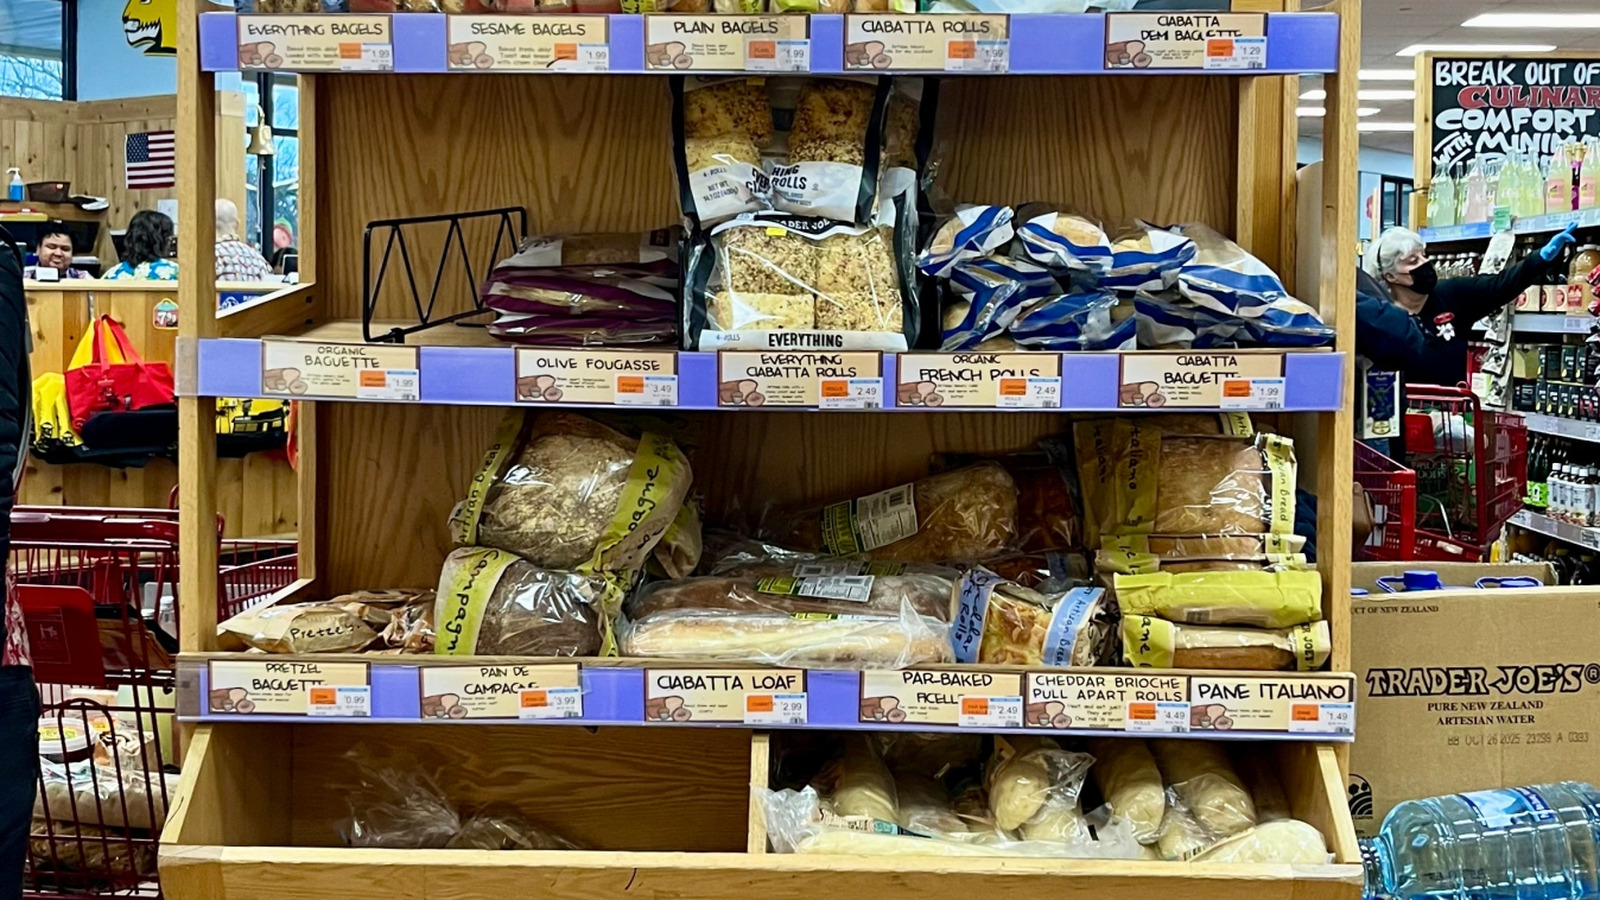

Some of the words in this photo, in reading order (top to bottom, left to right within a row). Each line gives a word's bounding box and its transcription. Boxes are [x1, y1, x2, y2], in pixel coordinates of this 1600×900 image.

[673, 21, 715, 34] PLAIN
[721, 21, 779, 34] BAGELS
[861, 20, 935, 34] CIABATTA
[942, 20, 990, 33] ROLLS
[1157, 15, 1220, 28] CIABATTA
[247, 24, 325, 37] EVERYTHING
[331, 23, 383, 36] BAGELS
[471, 22, 526, 36] SESAME
[533, 23, 586, 36] BAGELS
[1435, 60, 1517, 87] BREAK
[1525, 62, 1567, 85] OUT
[1573, 62, 1600, 85] OF
[1434, 107, 1596, 134] COMFORT
[1433, 131, 1474, 166] WITH
[768, 332, 843, 348] EVERYTHING
[317, 346, 366, 356] ORGANIC
[304, 355, 380, 369] BAGUETTE
[536, 357, 578, 369] OLIVE
[586, 358, 661, 371] FOUGASSE
[760, 354, 843, 366] EVERYTHING
[952, 354, 1002, 364] ORGANIC
[1176, 355, 1238, 367] CIABATTA
[746, 366, 810, 378] CIABATTA
[816, 366, 857, 378] ROLLS
[919, 368, 982, 382] FRENCH
[1279, 488, 1290, 522] Bread
[444, 549, 500, 652] Campagn
[1063, 599, 1087, 634] Artisan
[1367, 606, 1378, 614] OF
[1380, 606, 1398, 614] NEW
[1400, 605, 1439, 614] ZEALAND
[955, 602, 970, 642] Rolls
[265, 662, 322, 674] PRETZEL
[480, 667, 508, 678] PAIN
[513, 666, 530, 677] DE
[656, 674, 744, 691] CIABATTA
[751, 674, 796, 690] LOAF
[902, 671, 993, 687] PAR-BAKED
[1035, 674, 1106, 688] CHEDDAR
[1115, 677, 1180, 689] BRIOCHE
[1365, 666, 1490, 697] TRADER
[1032, 688, 1068, 700] PULL
[1076, 689, 1127, 702] APART
[1135, 690, 1183, 702] ROLLS
[1197, 683, 1250, 700] PANE
[1259, 683, 1346, 700] ITALIANO
[1427, 702, 1459, 712] PURE
[1460, 701, 1488, 711] NEW
[1489, 700, 1544, 711] ZEALAND
[1436, 715, 1494, 726] ARTESIAN
[1496, 714, 1536, 725] WATER
[1556, 732, 1563, 743] A
